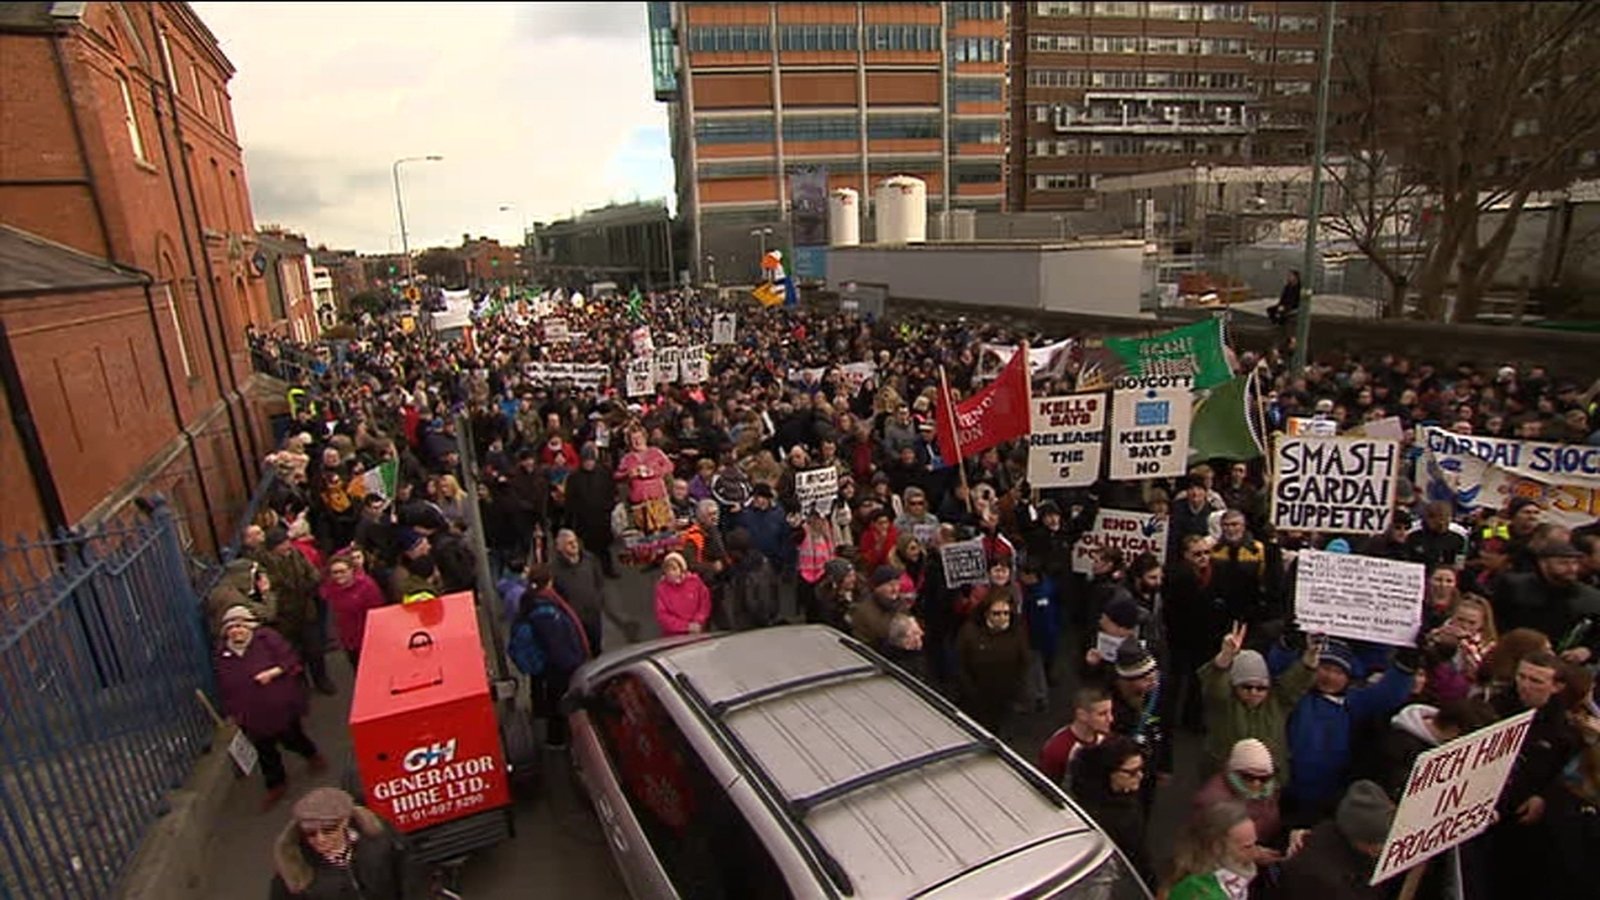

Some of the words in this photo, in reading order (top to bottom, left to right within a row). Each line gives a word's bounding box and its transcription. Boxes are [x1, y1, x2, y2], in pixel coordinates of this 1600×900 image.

[1114, 375, 1192, 390] BOYCOTT
[1040, 400, 1098, 415] KELLS
[1050, 413, 1091, 427] SAYS
[1031, 430, 1105, 446] RELEASE
[1119, 429, 1177, 444] KELLS
[1049, 451, 1084, 464] THE
[1128, 444, 1172, 458] SAYS
[1428, 430, 1522, 467] GARDAI
[1280, 442, 1395, 476] SMASH
[1059, 467, 1070, 478] 5
[1136, 462, 1161, 475] NO
[1277, 475, 1390, 506] GARDAI
[1102, 517, 1138, 531] END
[1276, 503, 1390, 530] PUPPETRY
[1082, 532, 1162, 552] OLITICAL
[1407, 744, 1471, 797] WITCH
[1472, 721, 1531, 770] HUNT
[374, 756, 495, 800] GENERATOR
[392, 786, 443, 814] HIRE
[446, 777, 490, 799] LTD.
[1432, 779, 1469, 817] IN
[1381, 800, 1496, 872] PROGRESS
